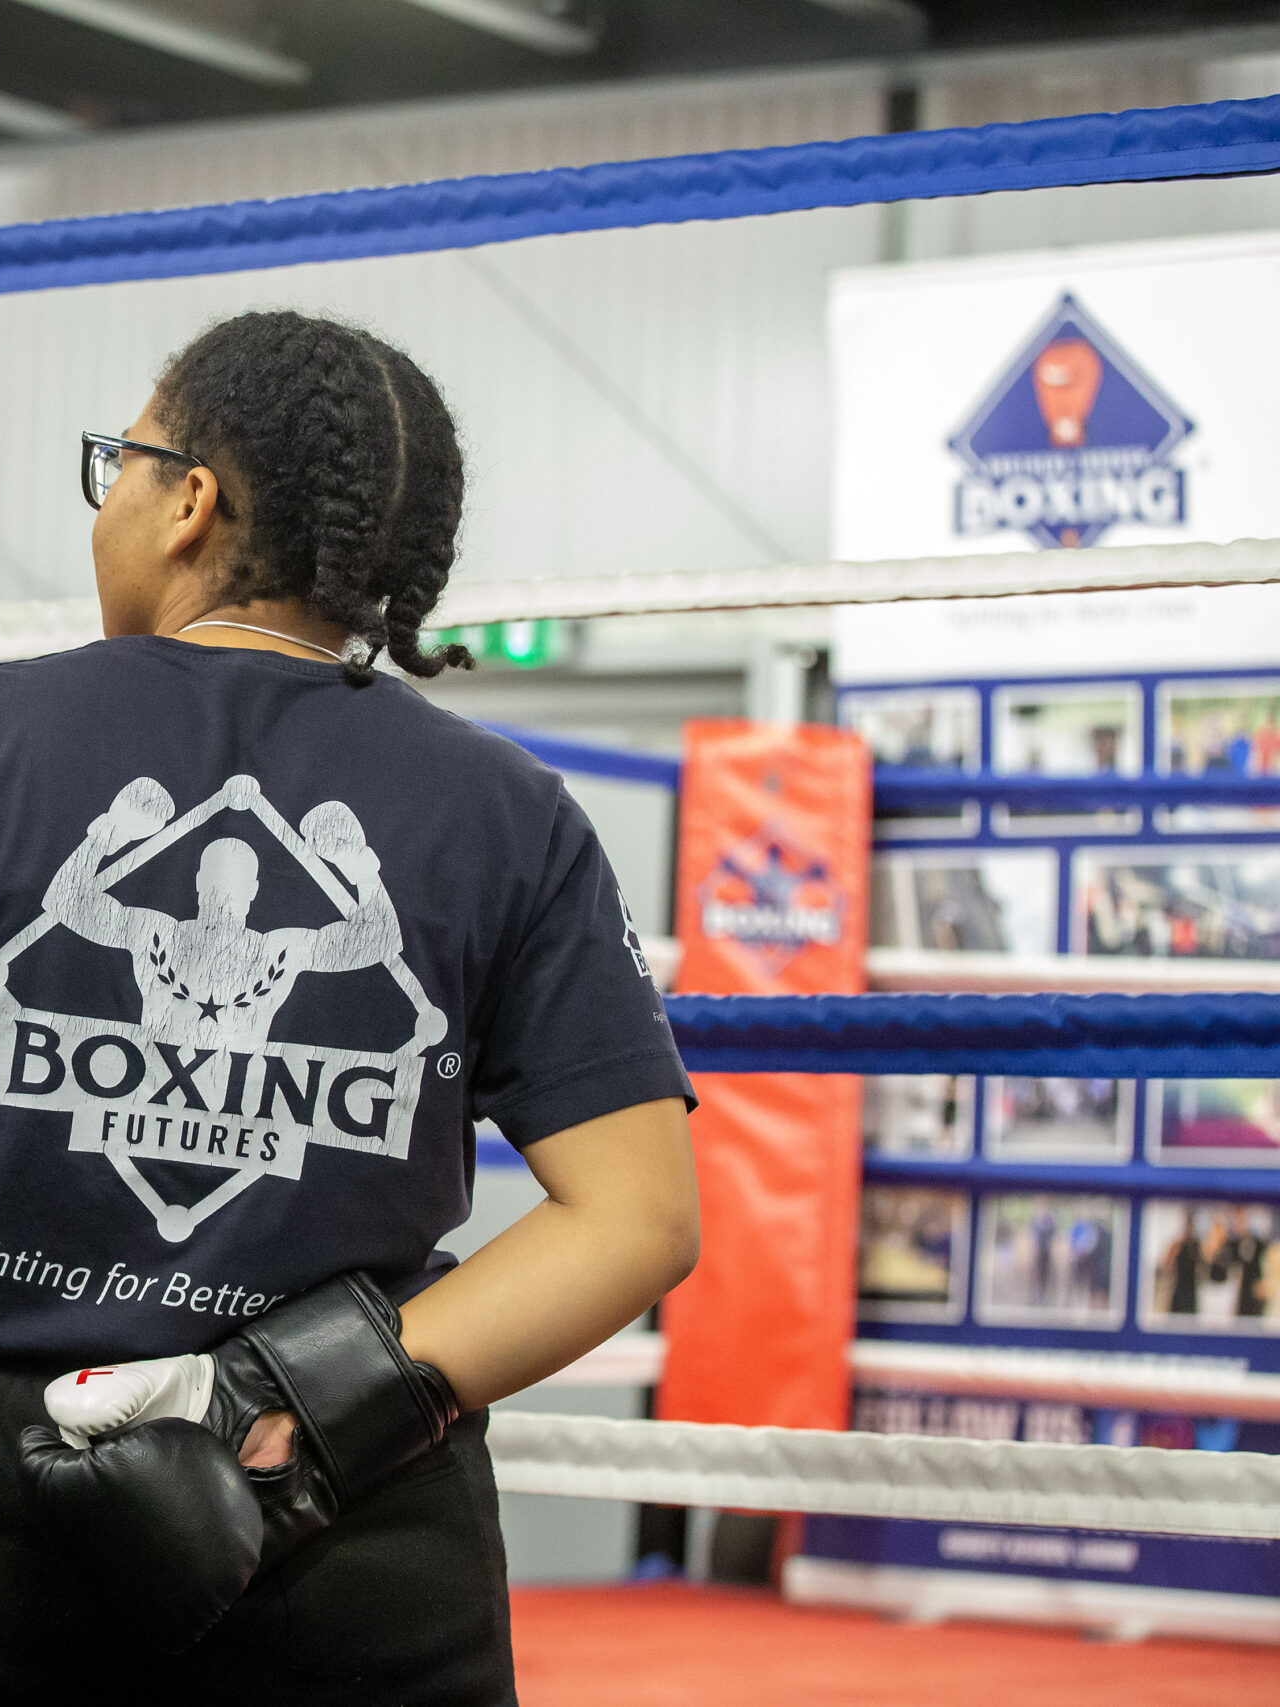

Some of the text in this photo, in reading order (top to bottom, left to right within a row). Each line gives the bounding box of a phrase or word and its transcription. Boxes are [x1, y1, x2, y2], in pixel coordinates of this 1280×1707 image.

[5, 1019, 397, 1143] BOXING
[101, 1110, 281, 1162] FUTURES
[95, 1262, 159, 1306] for
[160, 1271, 286, 1317] Better
